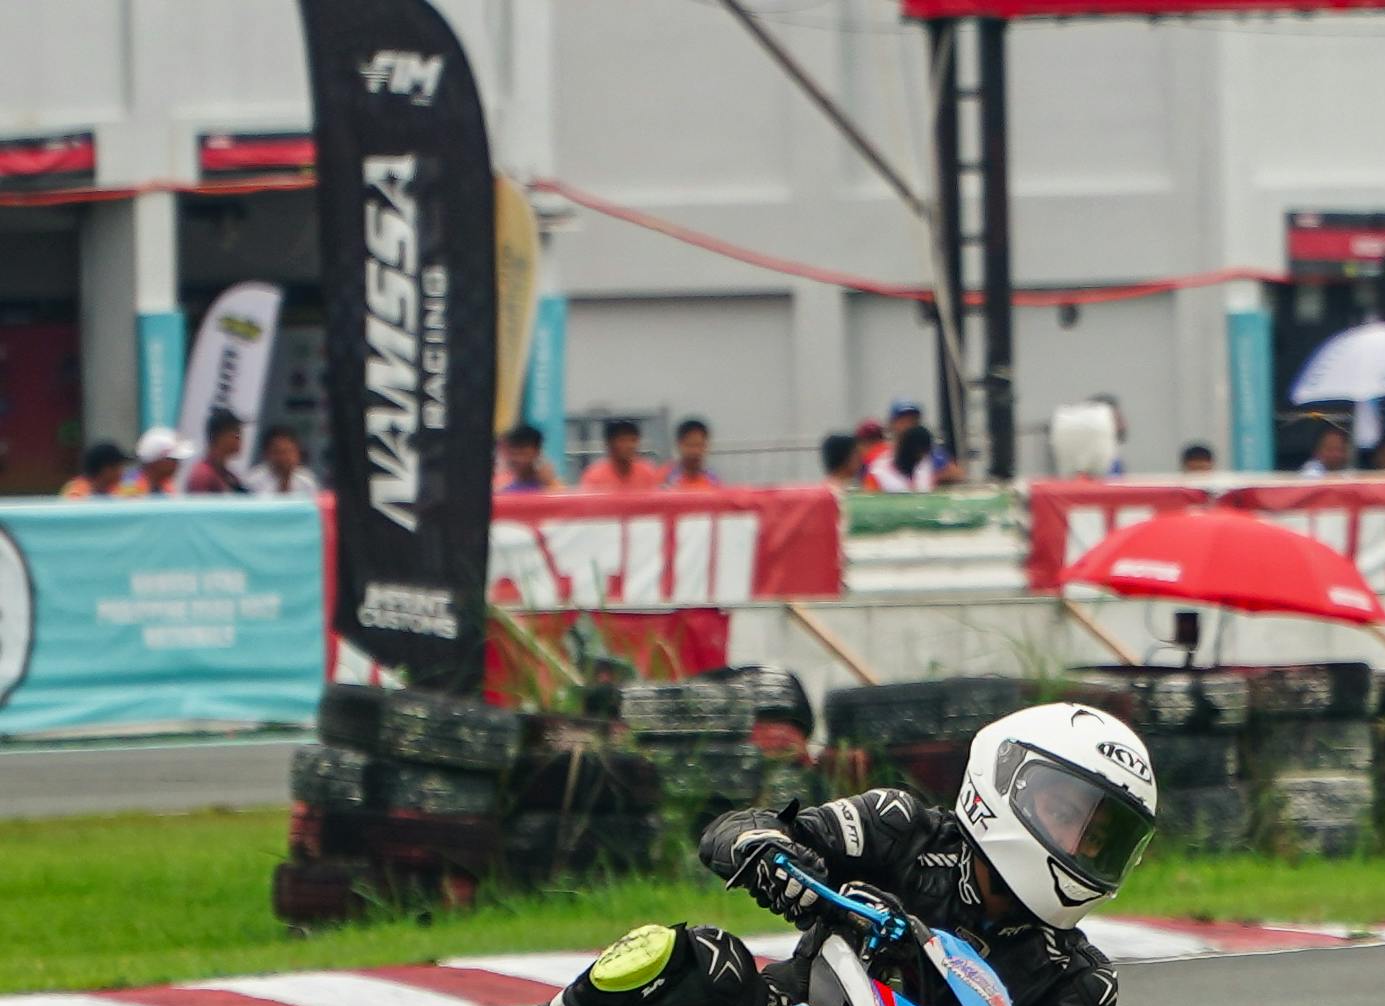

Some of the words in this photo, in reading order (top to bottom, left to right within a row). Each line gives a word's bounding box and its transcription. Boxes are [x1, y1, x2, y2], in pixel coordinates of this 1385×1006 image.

[365, 154, 418, 532] NAMSSA
[421, 265, 447, 429] RACING
[1097, 742, 1150, 778] KYT
